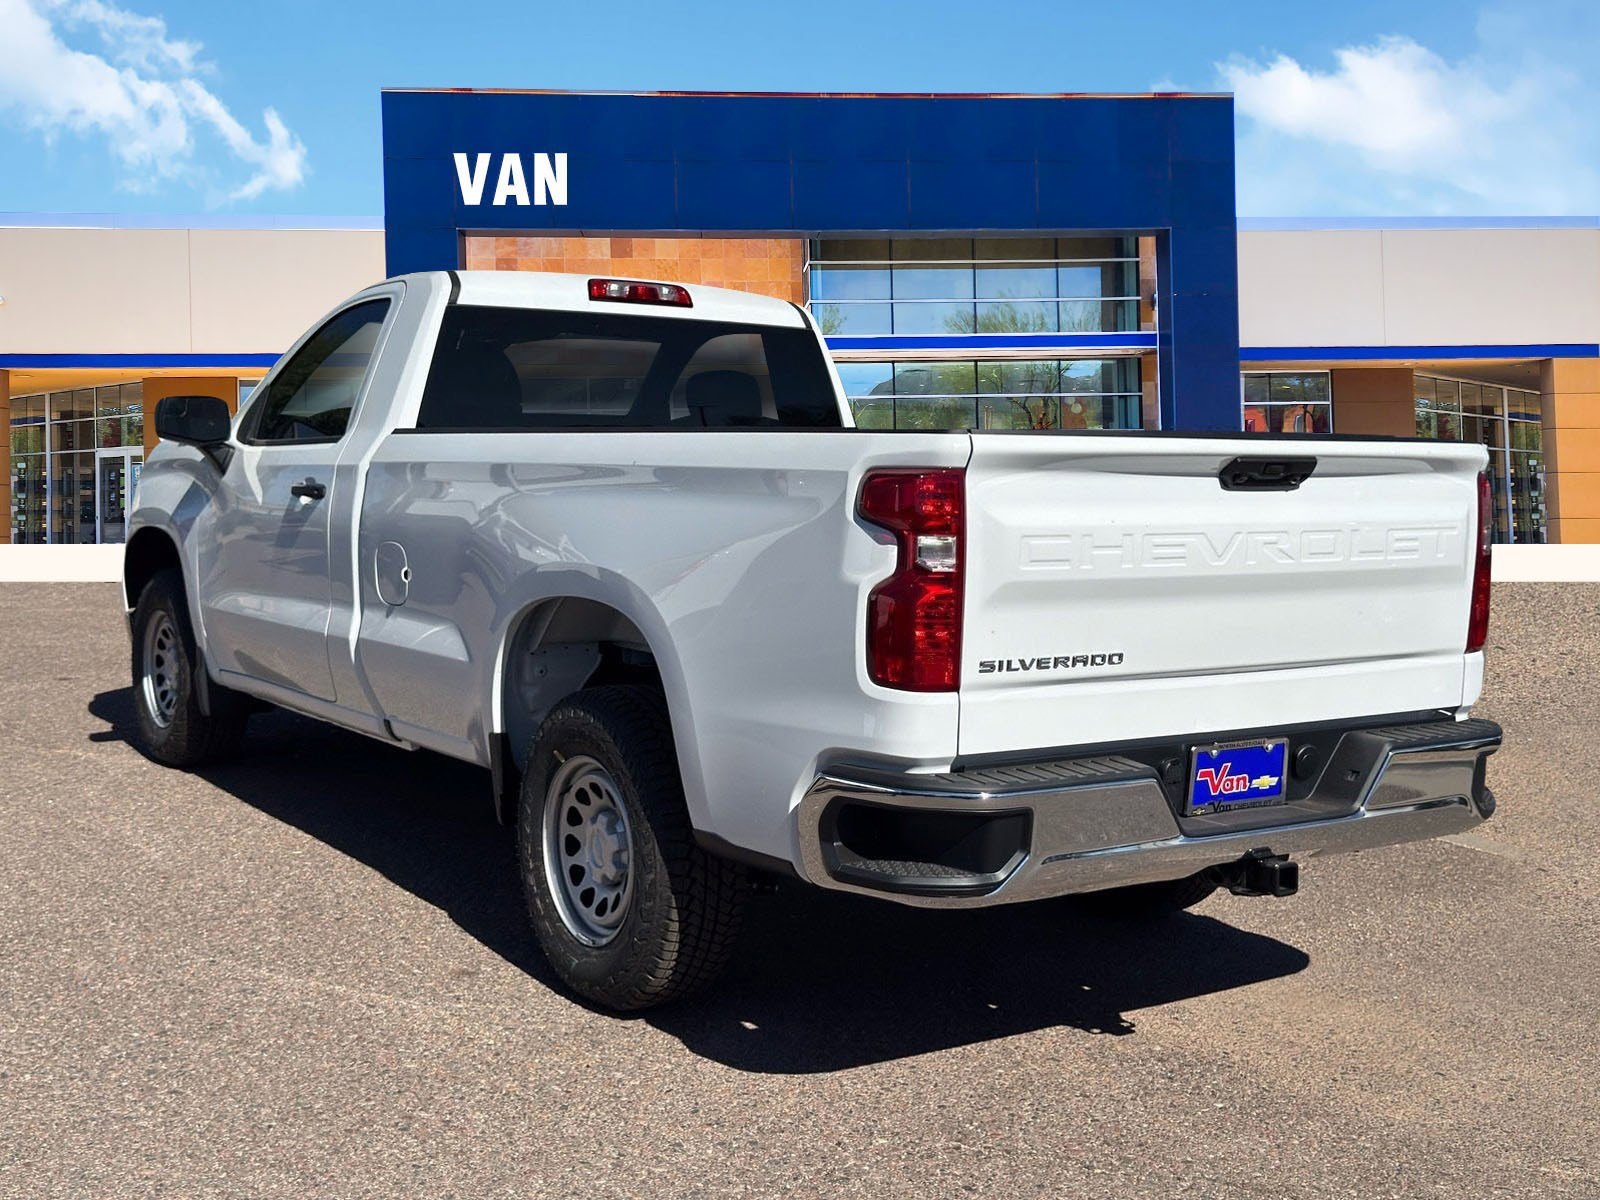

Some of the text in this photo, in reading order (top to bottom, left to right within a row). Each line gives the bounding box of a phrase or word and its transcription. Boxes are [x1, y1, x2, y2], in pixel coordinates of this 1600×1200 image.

[453, 152, 568, 206] VAN
[1019, 525, 1459, 571] CHEVROLET
[978, 652, 1125, 674] SILVERADO
[1197, 762, 1250, 795] Van
[1207, 798, 1231, 813] Van
